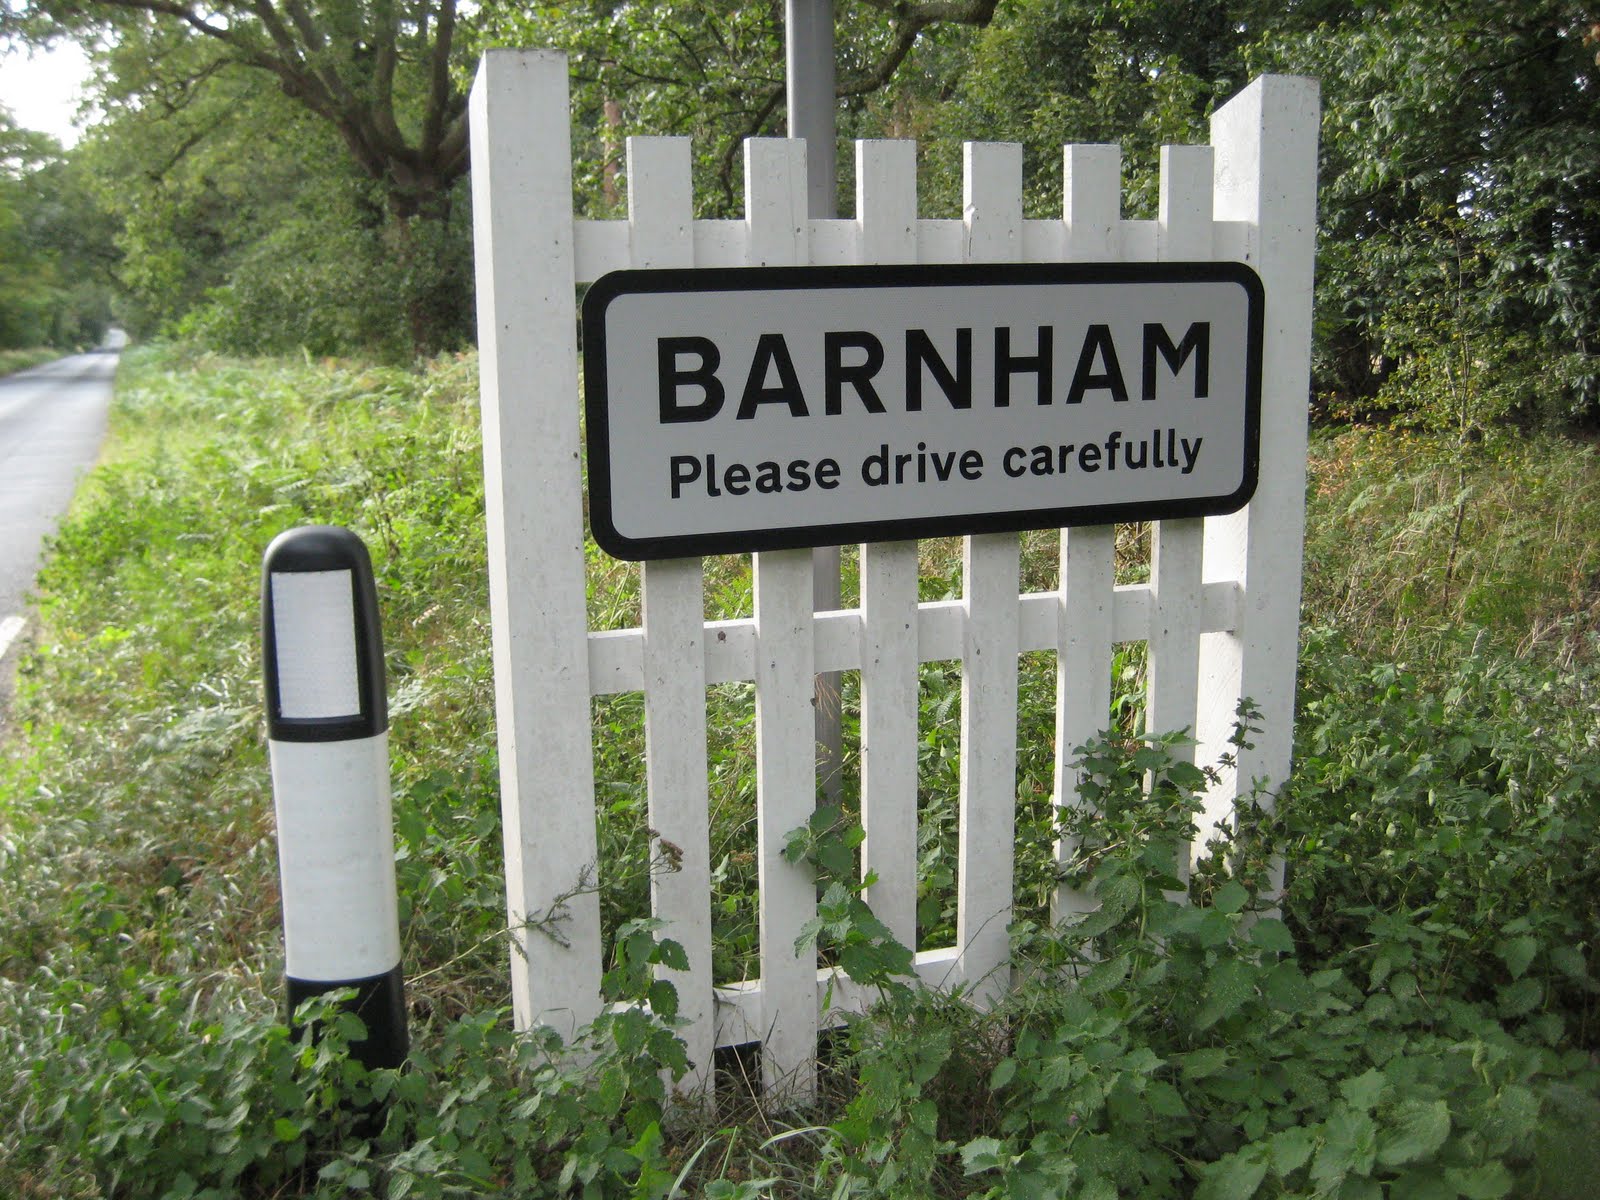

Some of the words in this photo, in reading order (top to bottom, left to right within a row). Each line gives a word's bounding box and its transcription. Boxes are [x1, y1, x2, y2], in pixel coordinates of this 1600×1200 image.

[657, 321, 1211, 425] BARNHAM
[669, 453, 841, 500] Please
[861, 441, 984, 487] drive
[1002, 427, 1204, 479] carefully
